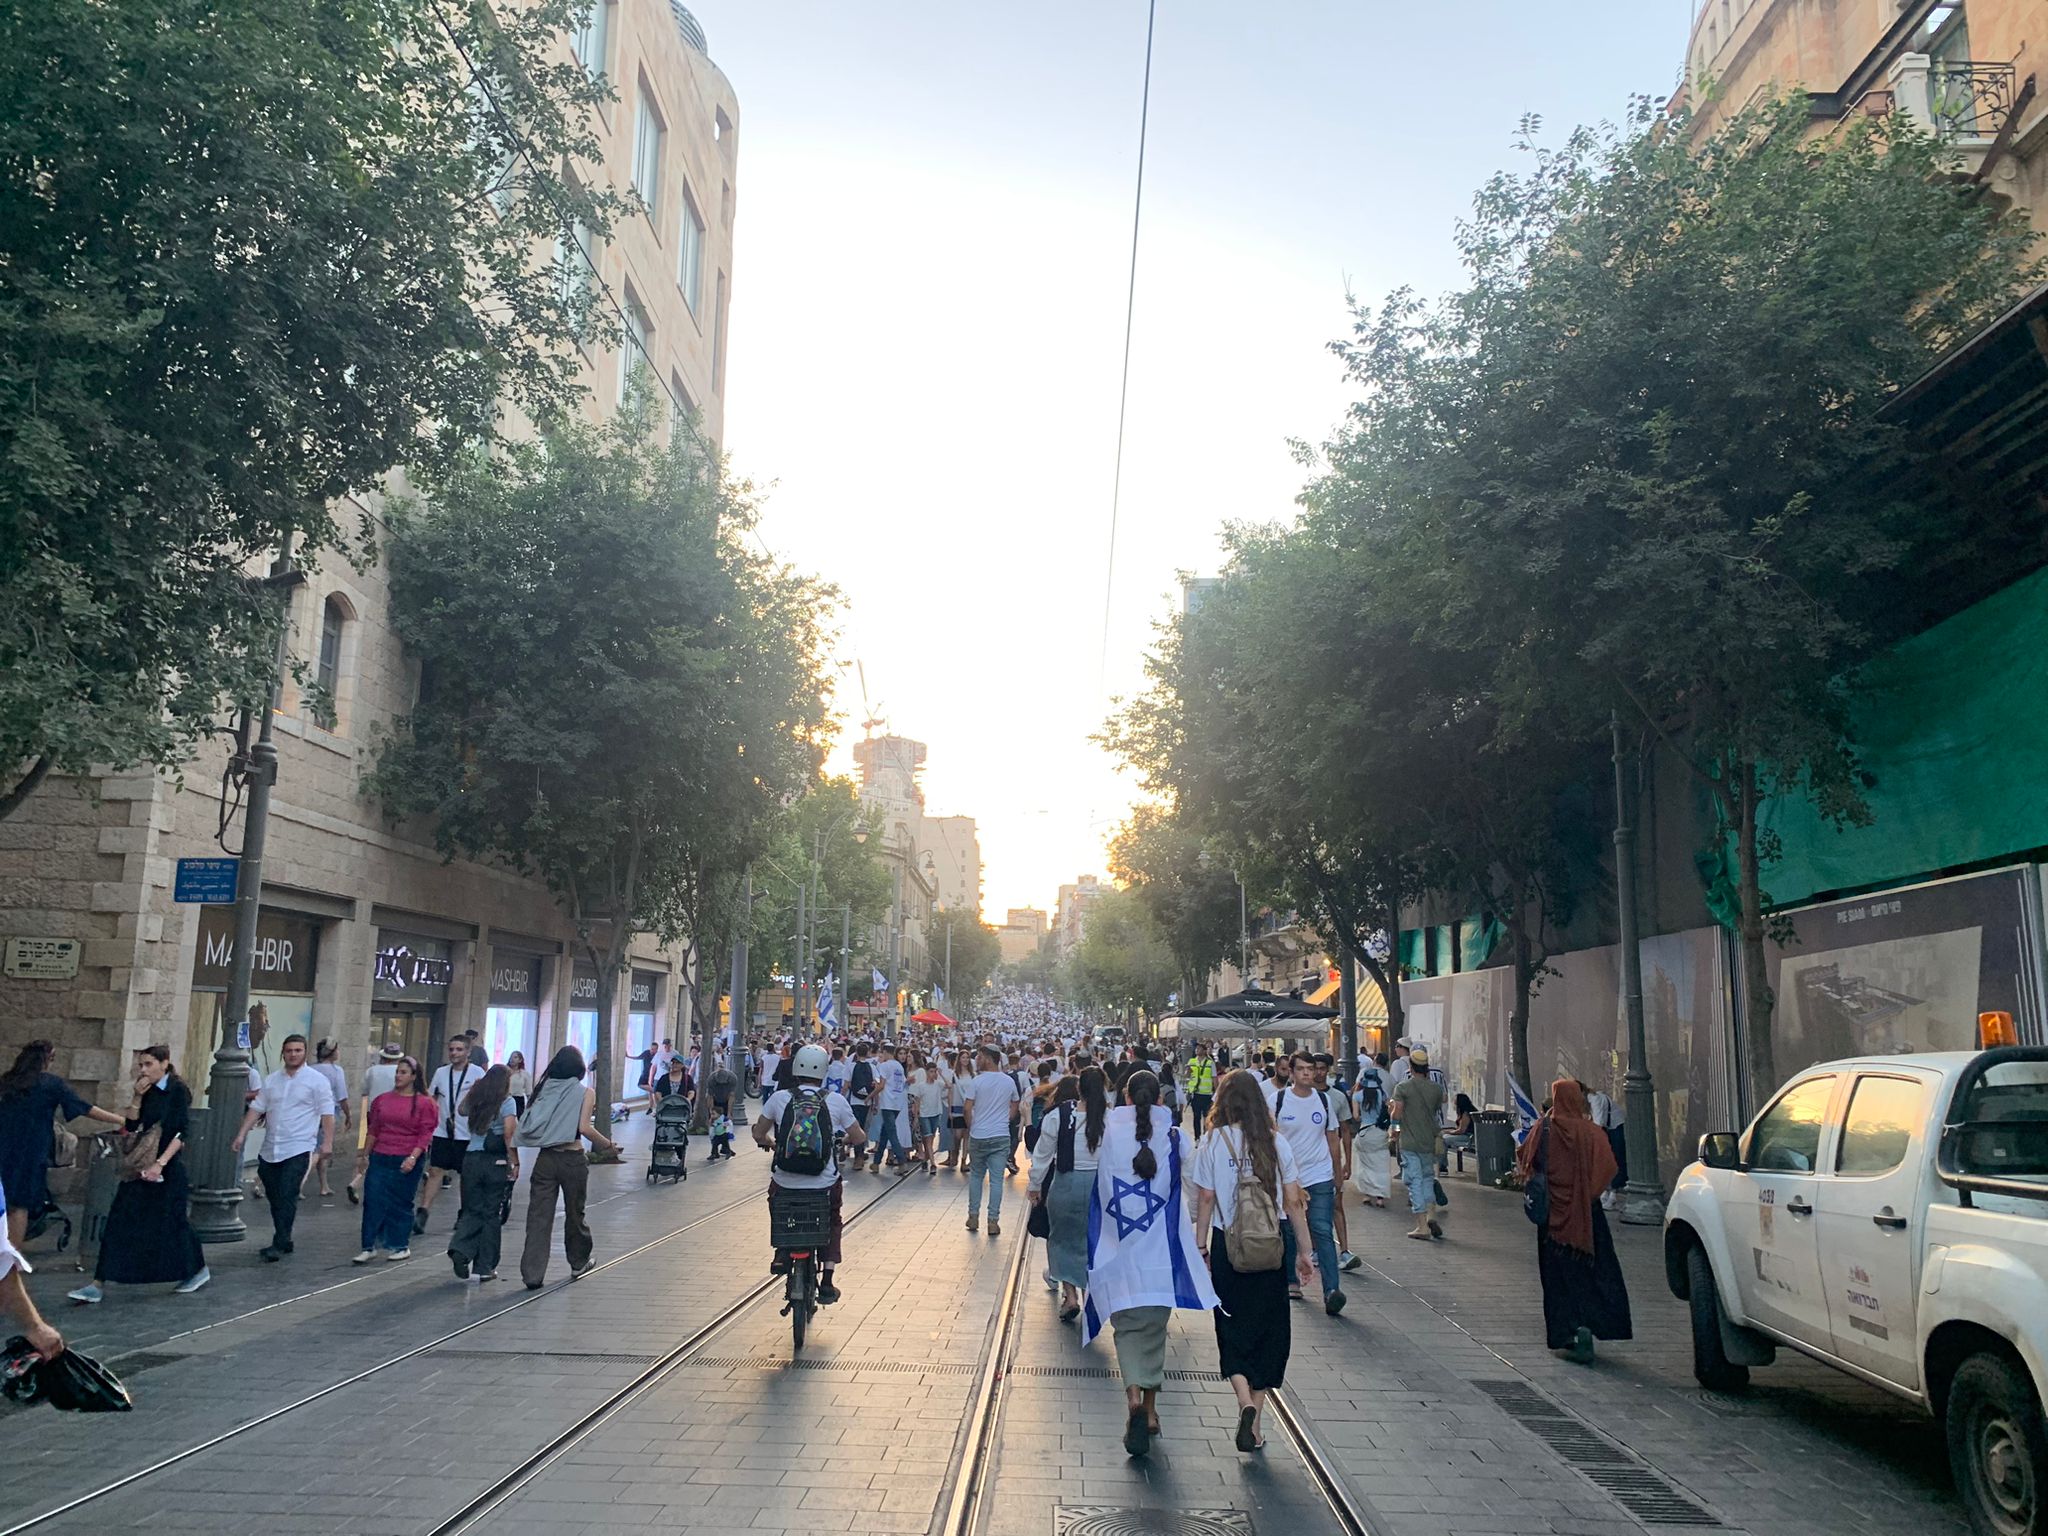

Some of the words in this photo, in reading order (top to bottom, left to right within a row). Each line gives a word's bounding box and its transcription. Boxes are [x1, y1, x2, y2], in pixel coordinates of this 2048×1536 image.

[204, 929, 294, 973] MAHBIR
[572, 977, 598, 998] ASHBIR
[631, 983, 650, 1002] ASHBIR
